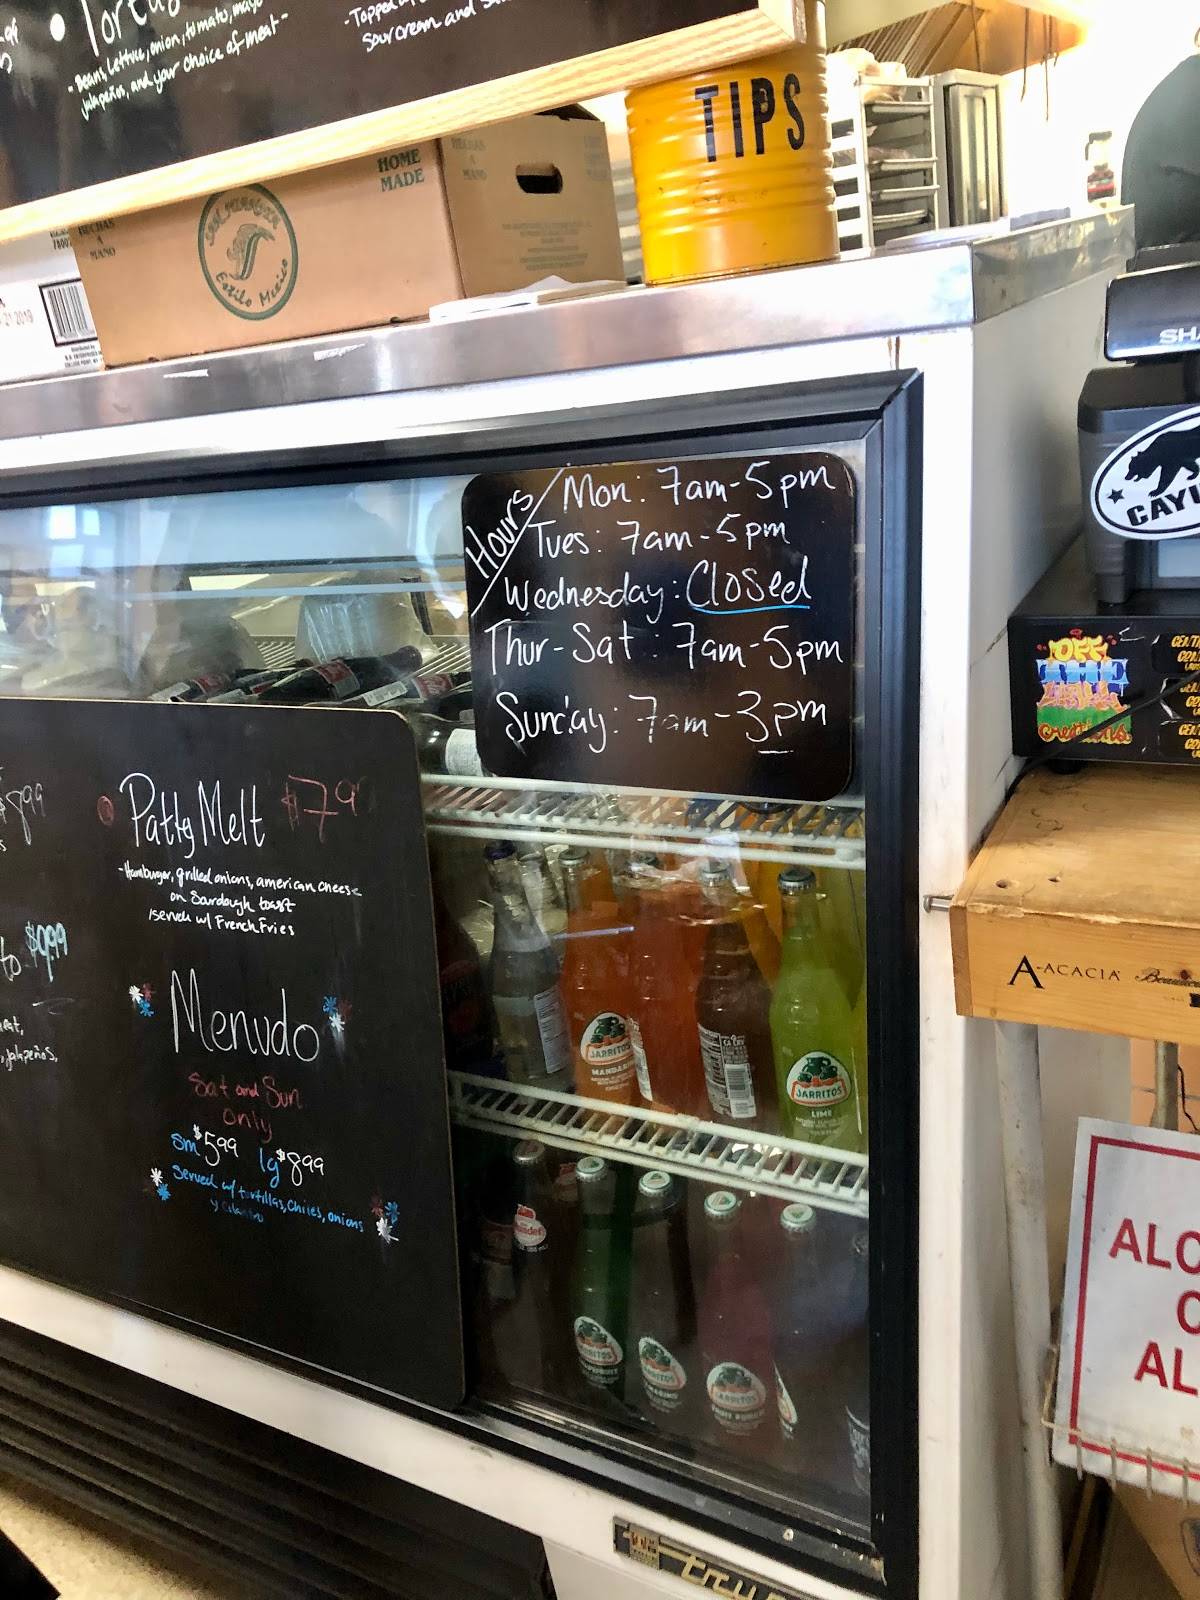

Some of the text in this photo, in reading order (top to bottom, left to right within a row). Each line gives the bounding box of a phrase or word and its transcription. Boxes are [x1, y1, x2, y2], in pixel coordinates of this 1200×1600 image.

[444, 0, 476, 26] and
[130, 69, 153, 92] and
[152, 61, 180, 94] your
[226, 29, 245, 56] of
[694, 73, 806, 163] TIPS
[377, 148, 421, 173] HOME
[380, 168, 424, 193] MADE
[562, 473, 648, 513] Mon:
[464, 488, 534, 579] Hours
[527, 520, 602, 559] Tues:
[502, 555, 812, 624] Wednesday: Closed
[1048, 635, 1109, 663] OFF
[119, 772, 195, 859] Patty
[198, 779, 266, 848] Melt
[176, 866, 213, 888] grilled
[256, 877, 316, 893] american
[318, 881, 362, 897] cheese
[170, 892, 187, 903] on
[258, 896, 296, 913] toast
[195, 912, 212, 930] w/
[214, 915, 260, 935] French
[258, 917, 295, 936] Fries
[171, 968, 320, 1062] Menudo
[590, 1041, 632, 1059] JARRITOS
[188, 1072, 303, 1109] Sat and Sun
[796, 1086, 843, 1100] JARRITOS
[811, 1109, 833, 1118] LIME
[221, 1179, 237, 1199] w/
[327, 1212, 365, 1233] onions
